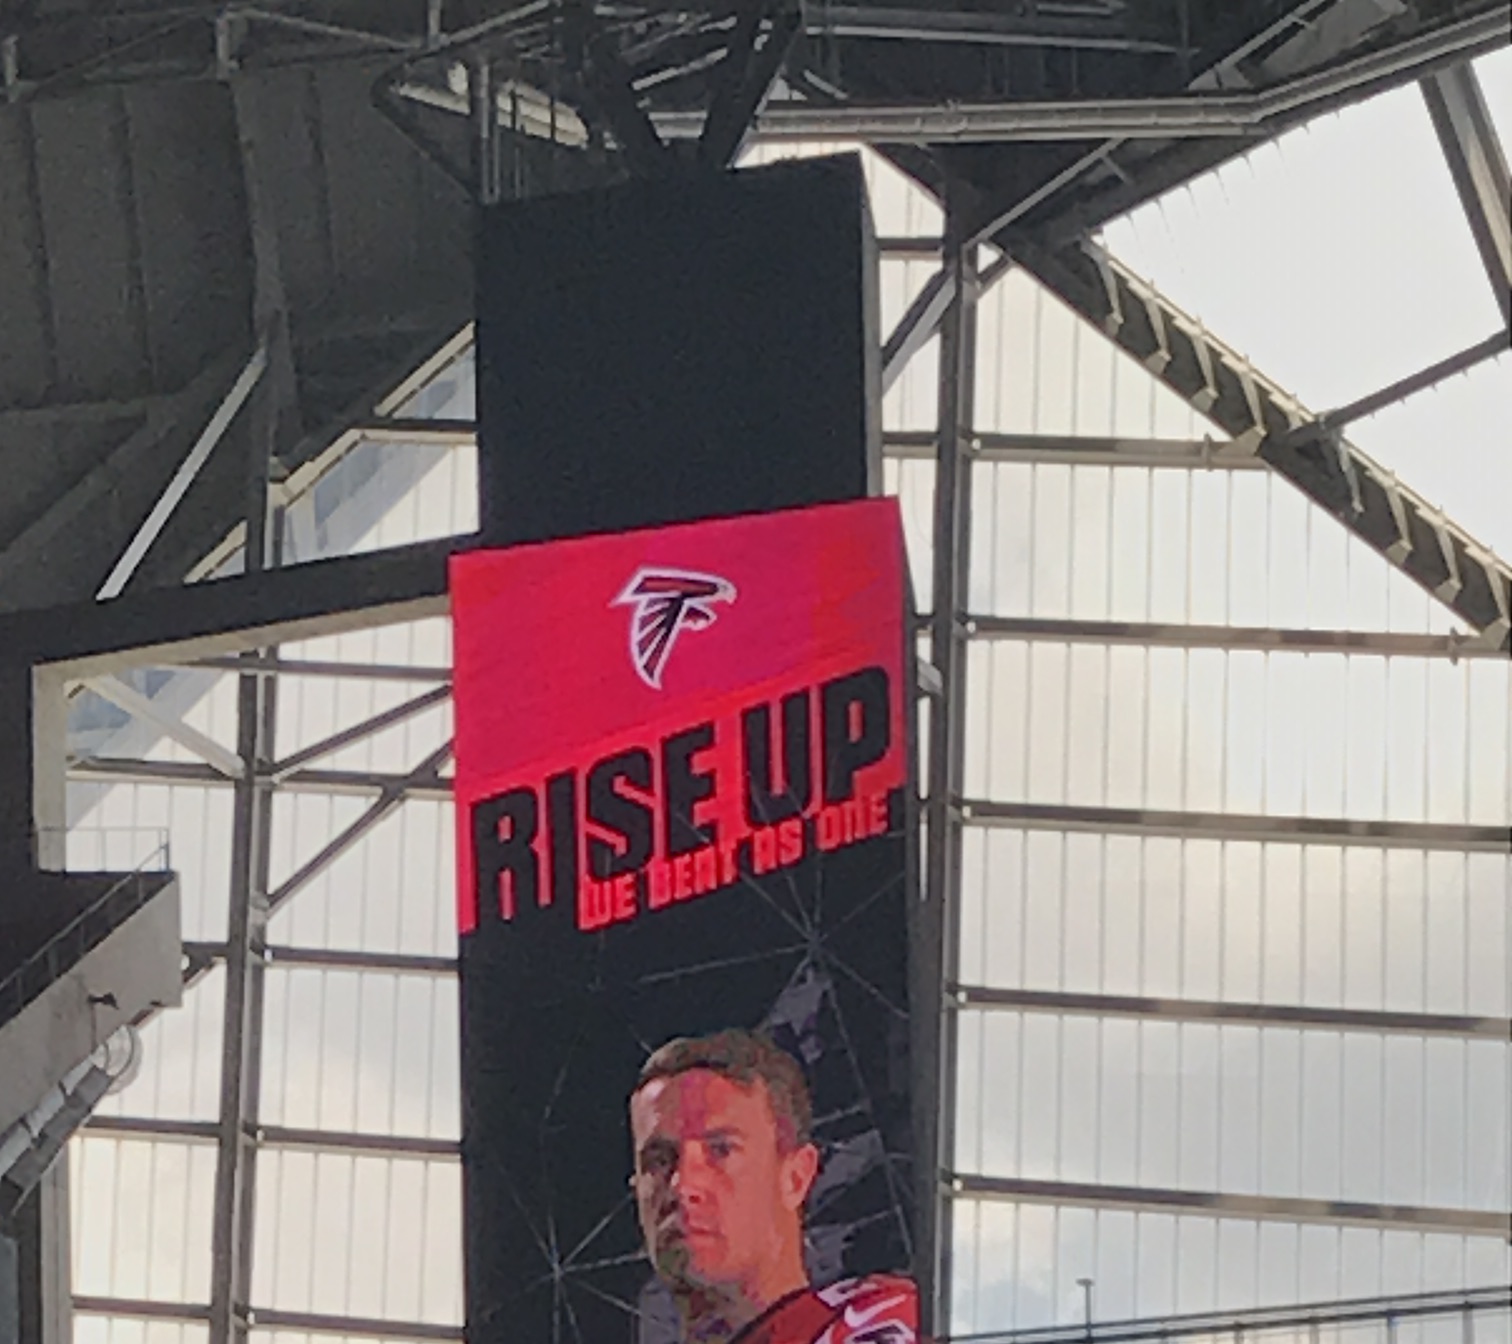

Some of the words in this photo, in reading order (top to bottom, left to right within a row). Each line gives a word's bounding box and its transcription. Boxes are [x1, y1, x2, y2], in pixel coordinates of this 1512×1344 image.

[471, 723, 717, 931] RISE
[741, 667, 891, 826] UP
[579, 872, 636, 931] WE
[648, 844, 738, 910] BEAT
[753, 818, 803, 876] AS
[816, 792, 888, 851] ONE
